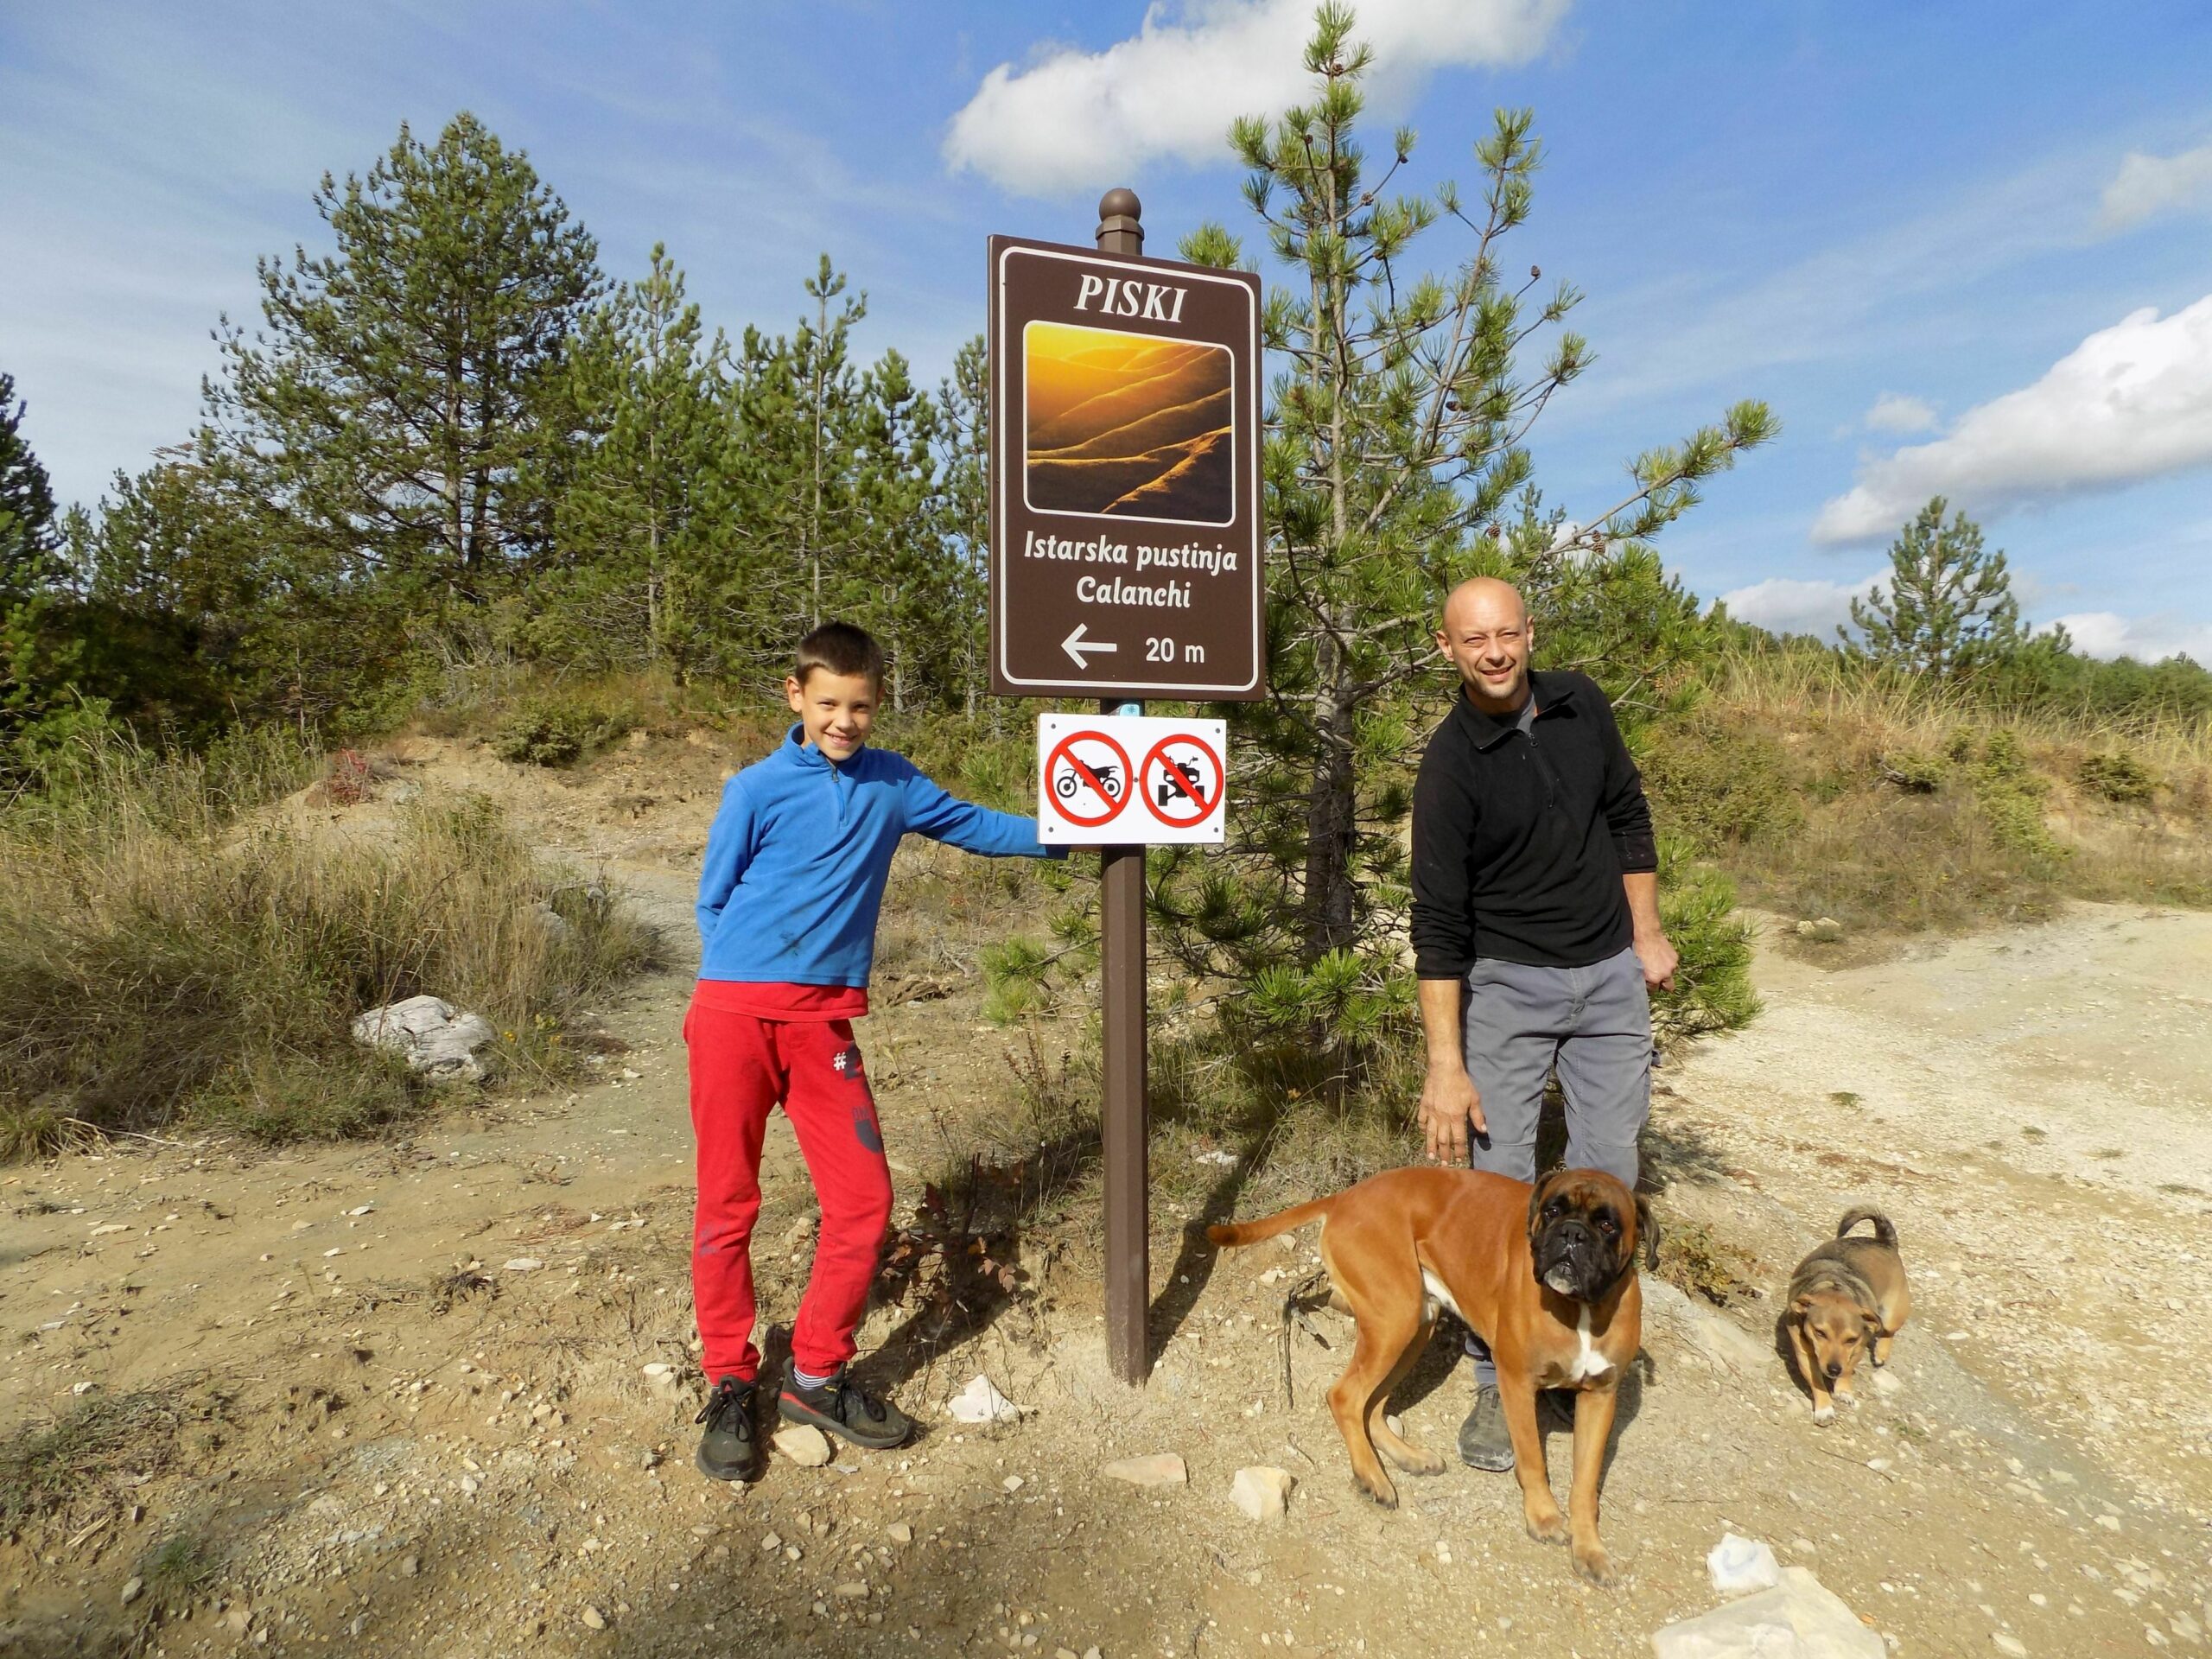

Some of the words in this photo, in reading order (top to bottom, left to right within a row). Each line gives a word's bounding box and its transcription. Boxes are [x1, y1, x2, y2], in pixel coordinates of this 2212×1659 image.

[1073, 274, 1188, 323] PISKI
[1024, 531, 1128, 564] Istarska
[1136, 542, 1237, 576] pustinja
[1076, 575, 1191, 608] Calanchi
[1145, 637, 1175, 663] 20
[1185, 645, 1205, 664] m
